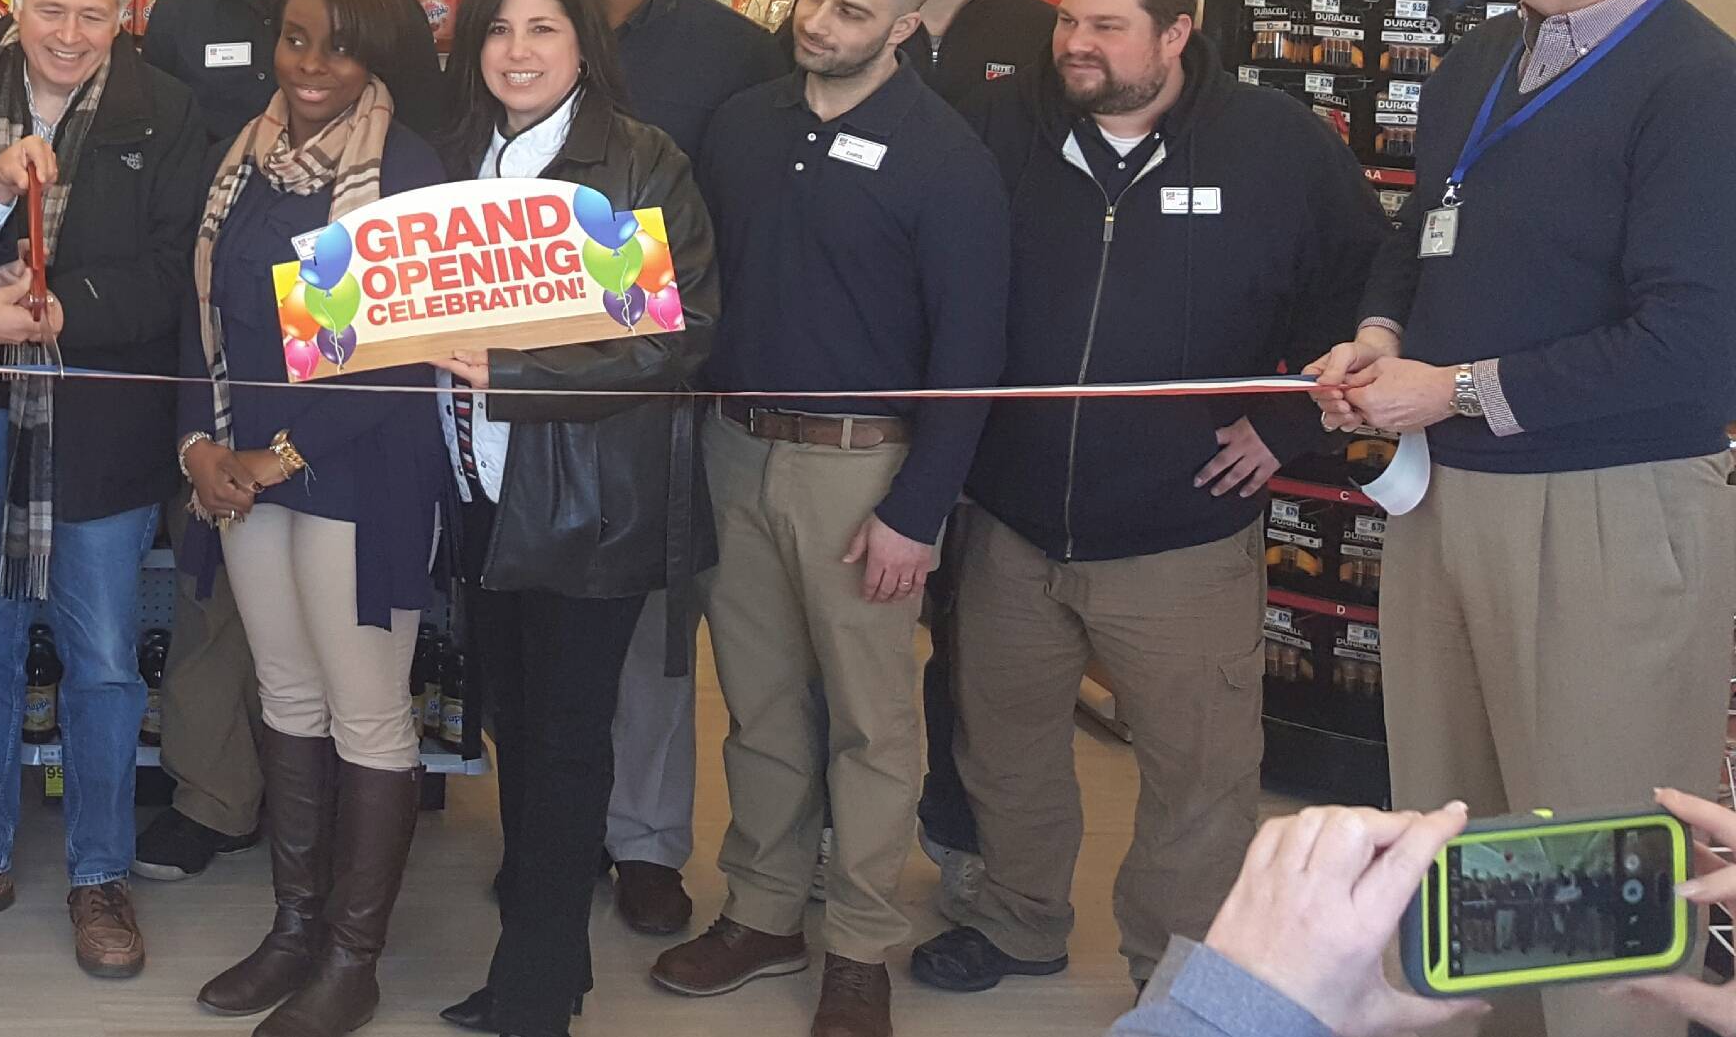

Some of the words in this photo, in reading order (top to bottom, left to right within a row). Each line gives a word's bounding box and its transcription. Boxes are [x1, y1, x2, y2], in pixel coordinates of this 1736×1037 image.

[1253, 7, 1289, 17] DURACELL
[1315, 12, 1361, 24] DURACELL
[1331, 29, 1341, 37] 10
[1403, 34, 1414, 42] 10
[1397, 115, 1408, 123] 10
[355, 194, 571, 262] GRAND
[362, 240, 581, 300] OPENING
[367, 277, 587, 326] CELEBRATION!
[1339, 490, 1350, 501] C
[1336, 604, 1346, 615] D
